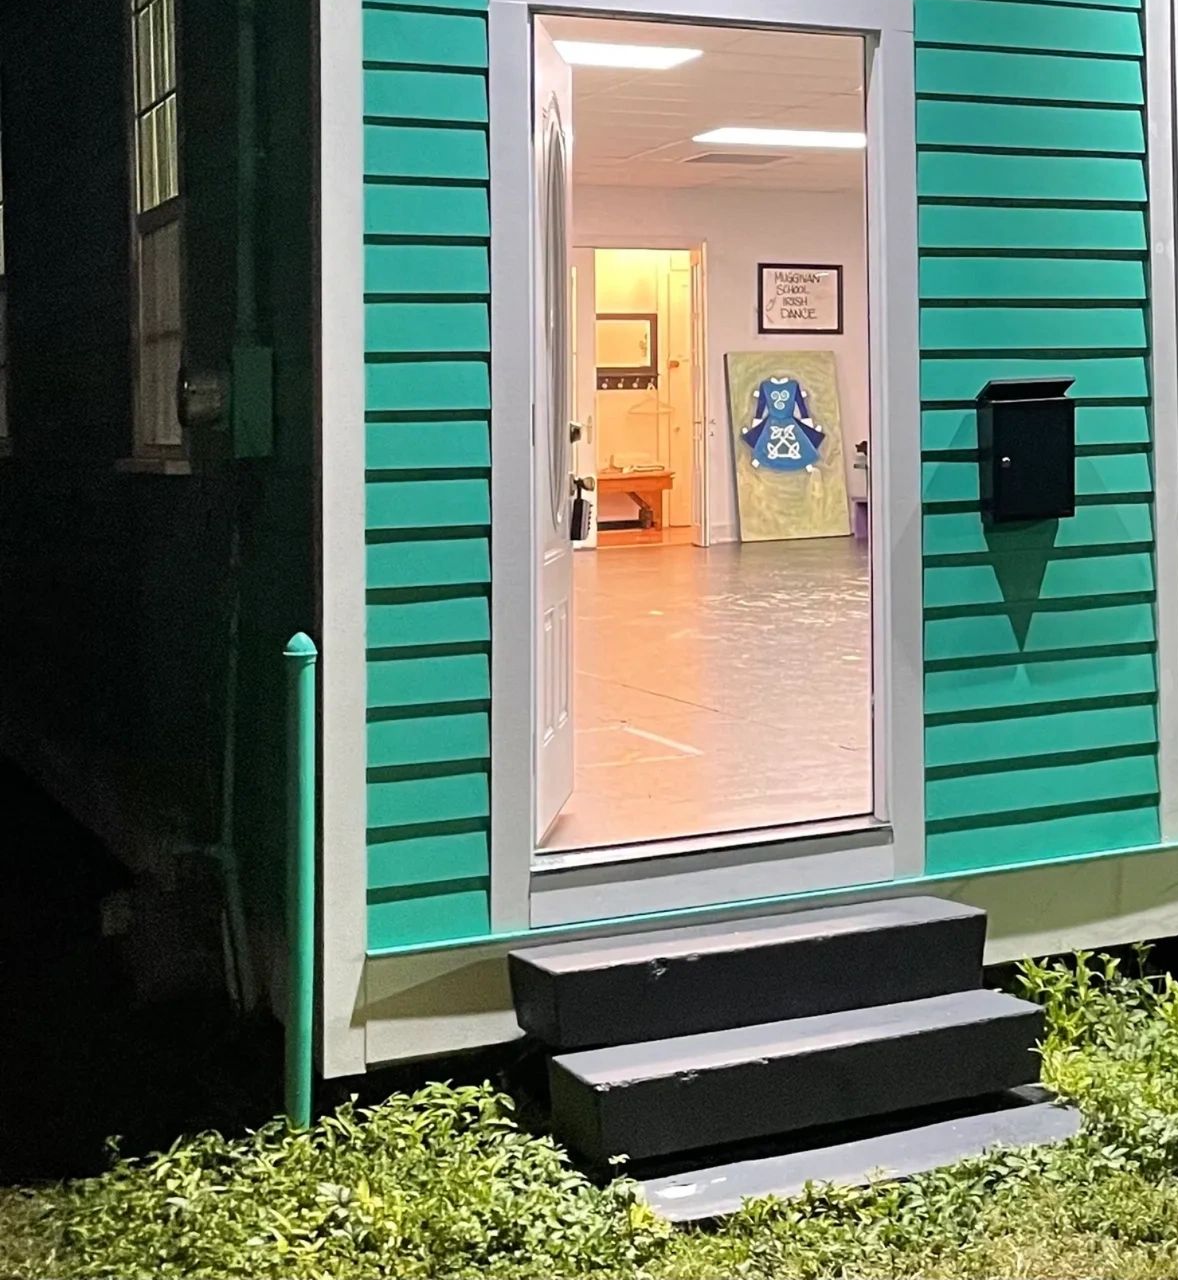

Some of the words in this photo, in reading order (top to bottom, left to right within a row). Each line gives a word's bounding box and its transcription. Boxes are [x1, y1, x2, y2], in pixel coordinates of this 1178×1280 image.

[776, 283, 811, 296] SCHOOL
[782, 296, 808, 306] IRISH
[780, 307, 818, 320] DANCE
